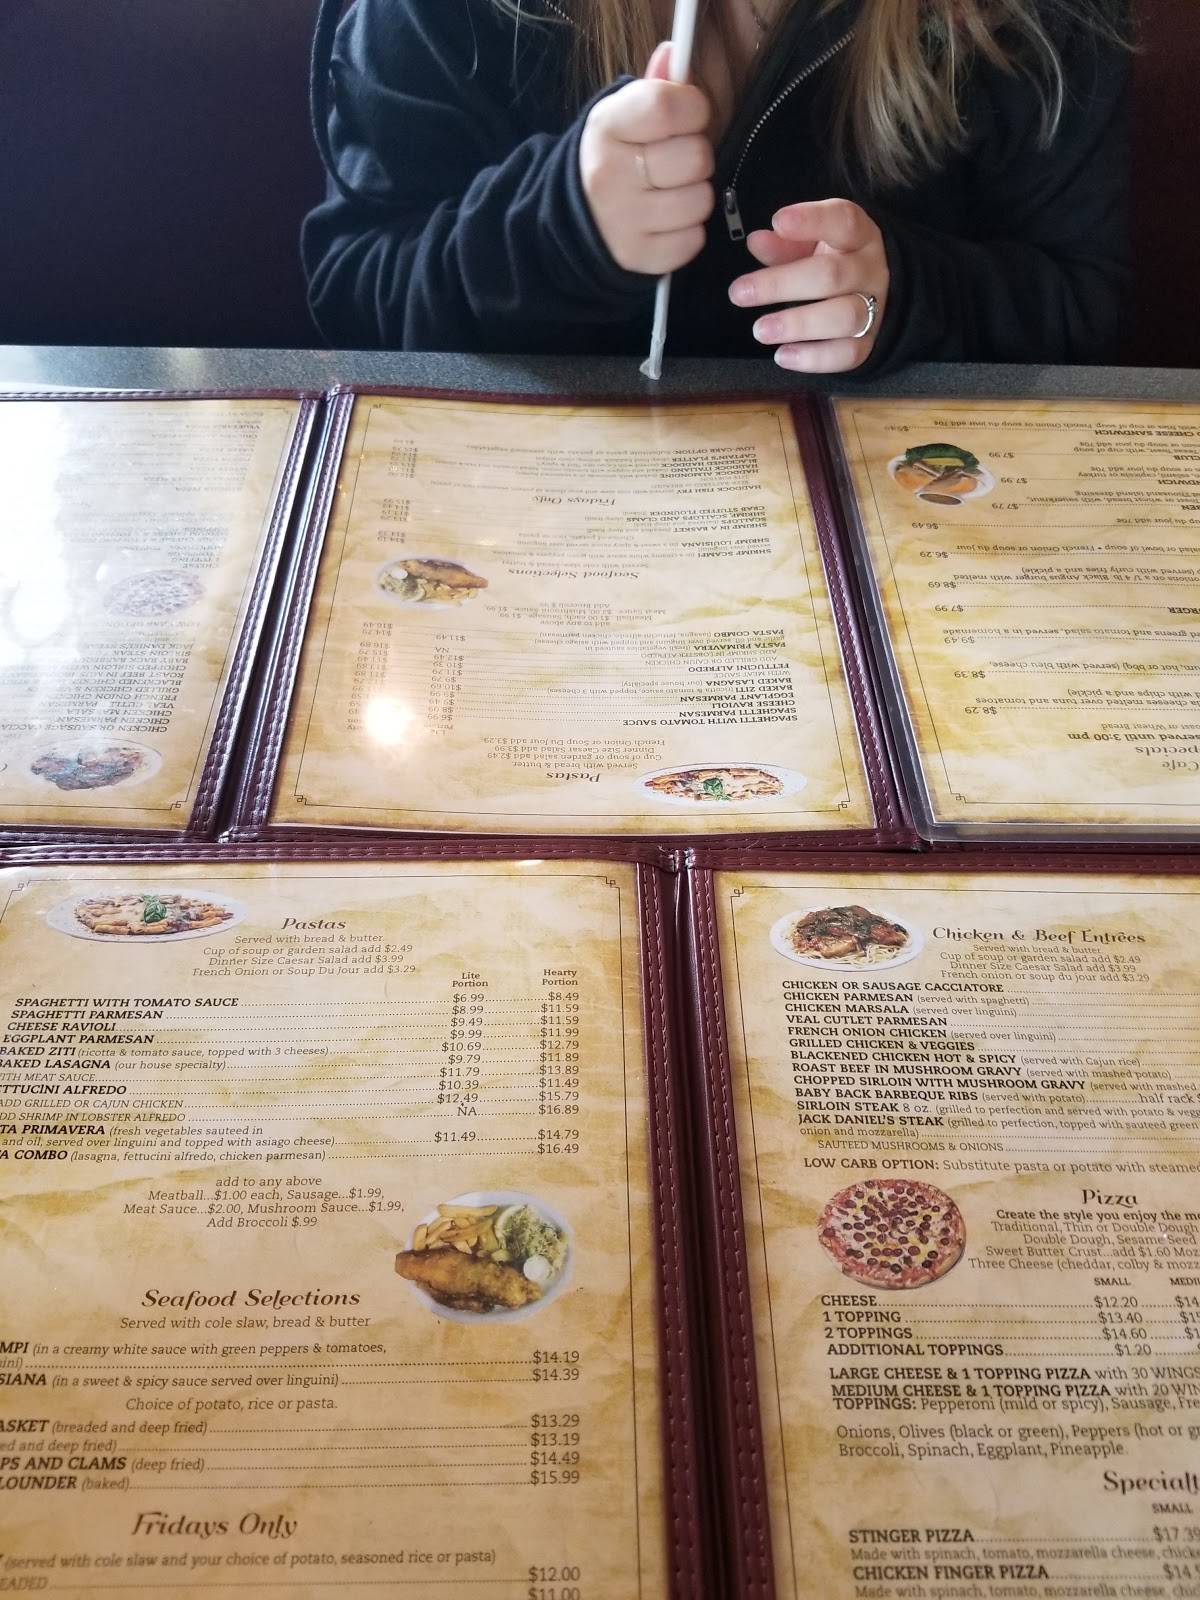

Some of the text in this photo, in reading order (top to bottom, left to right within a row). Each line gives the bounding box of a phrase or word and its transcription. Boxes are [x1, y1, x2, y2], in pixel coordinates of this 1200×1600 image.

[944, 636, 975, 644] $9.49
[736, 663, 789, 671] FETTUCINI
[757, 677, 792, 685] BAKED
[740, 692, 794, 700] EGGPLANT
[976, 697, 1026, 705] tomatoes
[1028, 697, 1050, 705] and
[1106, 698, 1143, 706] melted
[965, 706, 997, 714] $8.29
[1068, 732, 1090, 740] pm
[546, 772, 600, 782] Pastas
[281, 918, 347, 930] Pastas
[235, 936, 272, 944] Served
[933, 927, 1004, 942] Chicken
[1011, 930, 1024, 940] &
[1033, 930, 1072, 942] Beef
[278, 957, 315, 965] Caesar
[318, 956, 348, 964] Salad
[375, 955, 403, 963] $3.99
[543, 969, 577, 977] Hearty
[782, 981, 1004, 992] CHICKEN OR SAUSAGE CACCIATORE
[15, 992, 579, 1008] SPAGHETTI WITH TOMATO SAUCE $6.99 $8.49
[11, 1004, 579, 1019] SPAGHETTI PARMESAN $8.99 $11.59
[785, 1004, 909, 1013] CHICKEN MARSALA
[787, 1015, 947, 1026] VEAL CUTLET PARMESAN
[790, 1039, 975, 1050] GRILLED CHICKEN & VEGGIES
[44, 1053, 579, 1070] LASAGNA (our house specialty) $9.79 $11.89
[63, 1078, 579, 1095] ALFREDO $10.39 $11.49
[795, 1088, 977, 1101] BABY BACK BARBEQUE RIBS
[457, 1105, 579, 1116] NA $16.89
[798, 1114, 944, 1126] JACK DANIEL'S STEAK
[21, 1126, 105, 1135] PRIMAVERA
[14, 1143, 579, 1160] COMBO $16.49
[804, 1158, 939, 1170] LOW CARB OPTION:
[1082, 1189, 1138, 1208] Pizza
[207, 1217, 232, 1227] Add
[237, 1217, 288, 1227] Broccoli
[996, 1210, 1181, 1222] Create the style you enjoy the
[1094, 1278, 1130, 1286] SMALL
[141, 1289, 360, 1310] Seafood Selections
[821, 1296, 1138, 1308] CHEESE $12.20
[121, 1316, 370, 1329] Served with cole slaw, bread & butter
[824, 1311, 1142, 1324] 1 TOPPING $13.40
[828, 1344, 1151, 1357] ADDITIONAL TOPPINGS $1.20
[840, 1444, 904, 1459] Broccoli,
[908, 1444, 973, 1459] Spinach,
[977, 1444, 1046, 1461] Eggplant,
[25, 1451, 580, 1471] AND CLAMS $14.49
[1152, 1503, 1192, 1514] SMALL
[131, 1512, 297, 1539] Fridays Only
[849, 1529, 974, 1543] STINGER PIZZA
[528, 1566, 580, 1583] $12.00
[853, 1566, 1049, 1581] CHICKEN FINGER PIZZA
